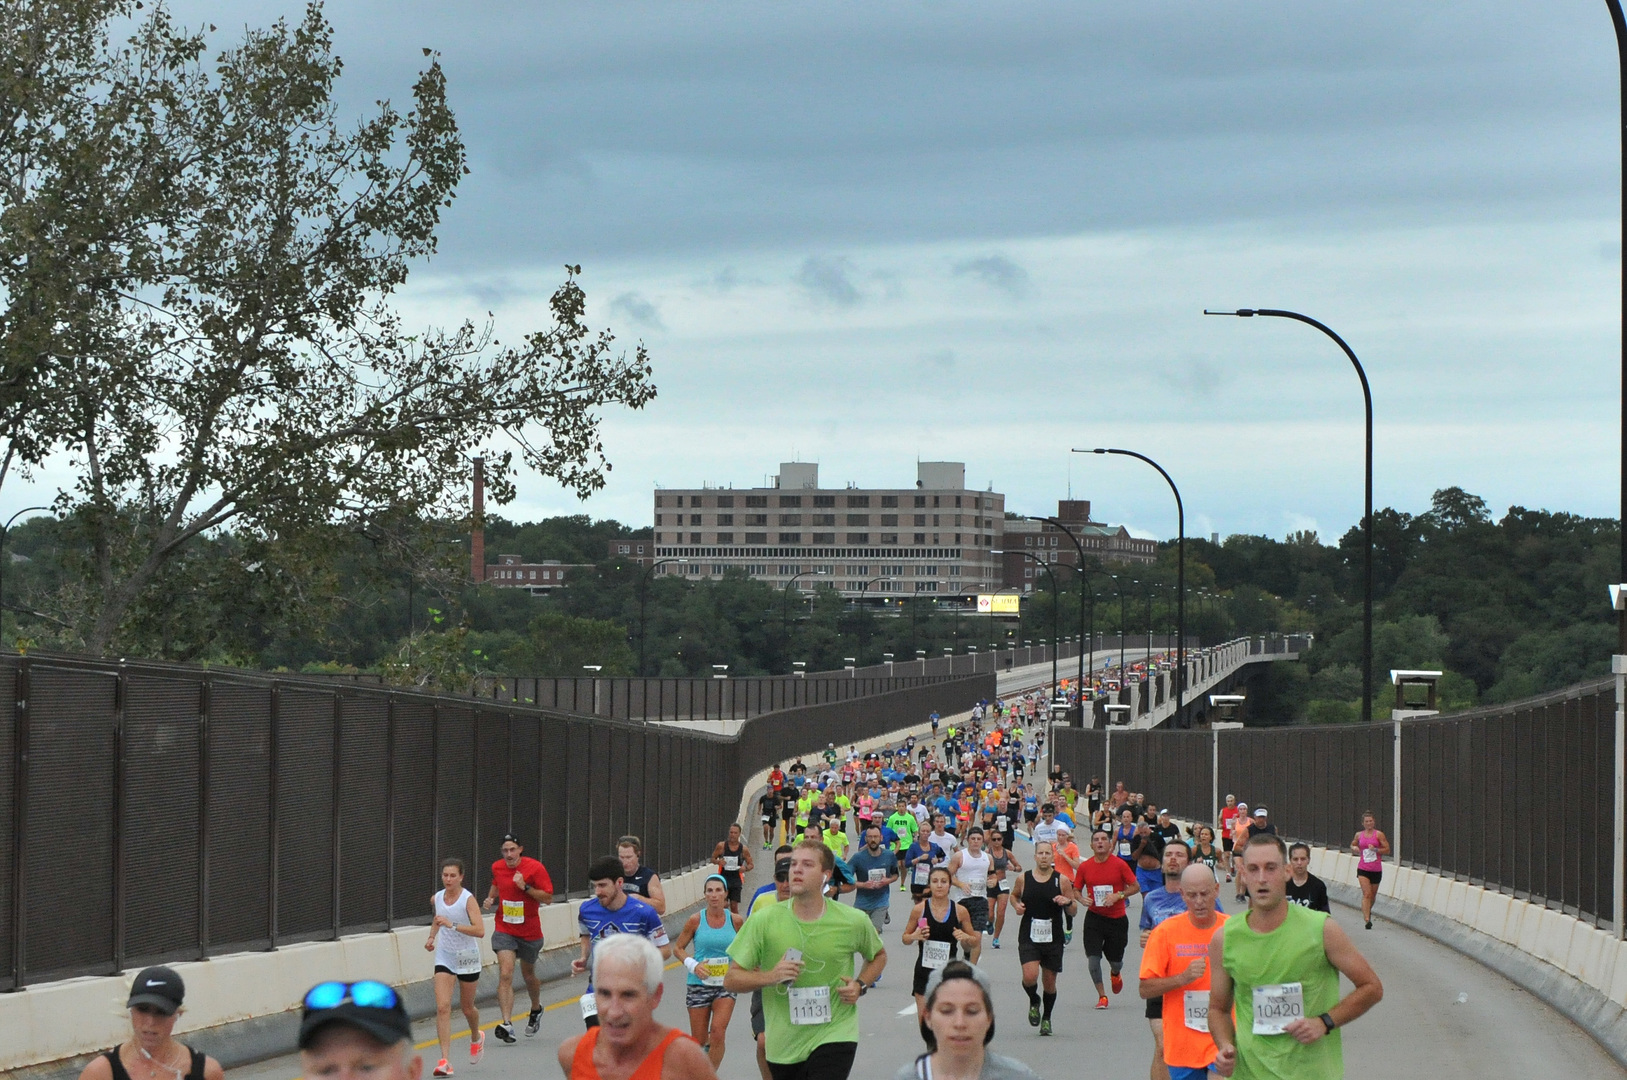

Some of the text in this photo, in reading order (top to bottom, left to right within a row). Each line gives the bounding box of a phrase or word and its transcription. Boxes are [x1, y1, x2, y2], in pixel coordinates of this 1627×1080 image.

[925, 951, 949, 961] 13290
[709, 968, 725, 977] 364
[793, 1005, 829, 1018] 11131
[1257, 1003, 1300, 1018] 10420
